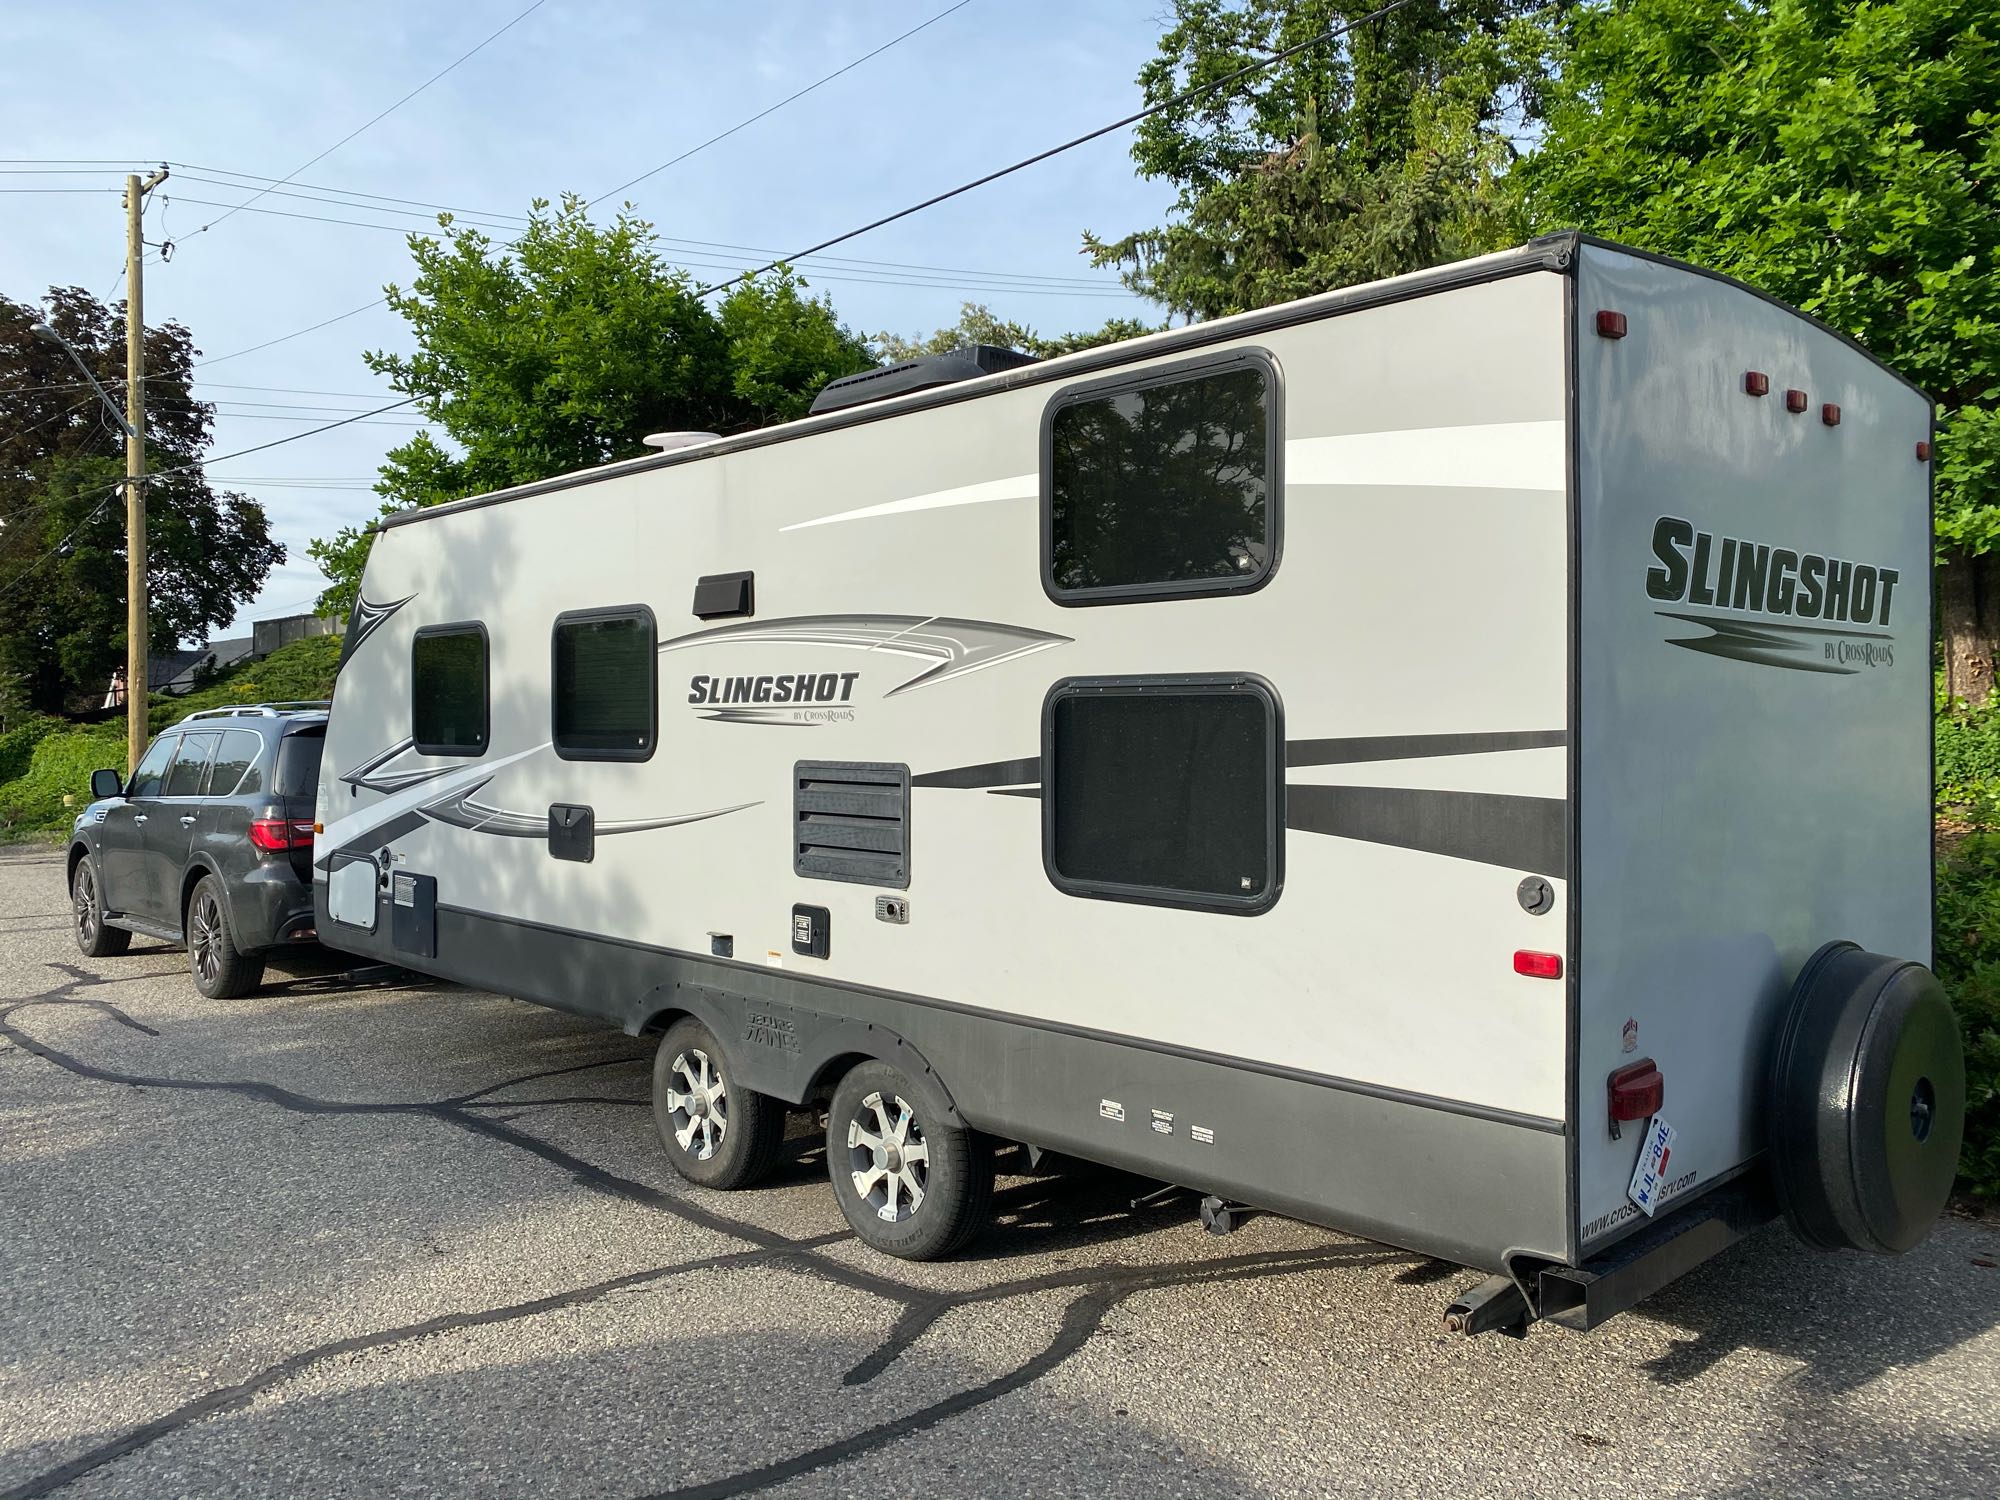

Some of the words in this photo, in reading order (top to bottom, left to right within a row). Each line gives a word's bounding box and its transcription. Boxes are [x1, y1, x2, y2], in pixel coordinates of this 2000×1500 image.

[1646, 516, 1899, 627] SLINGSHOT
[1824, 643, 1836, 659] BY
[688, 672, 860, 704] SLINGSHOT
[793, 712, 802, 720] BY
[1638, 1172, 1656, 1204] WJL
[1653, 1122, 1670, 1158] 84E
